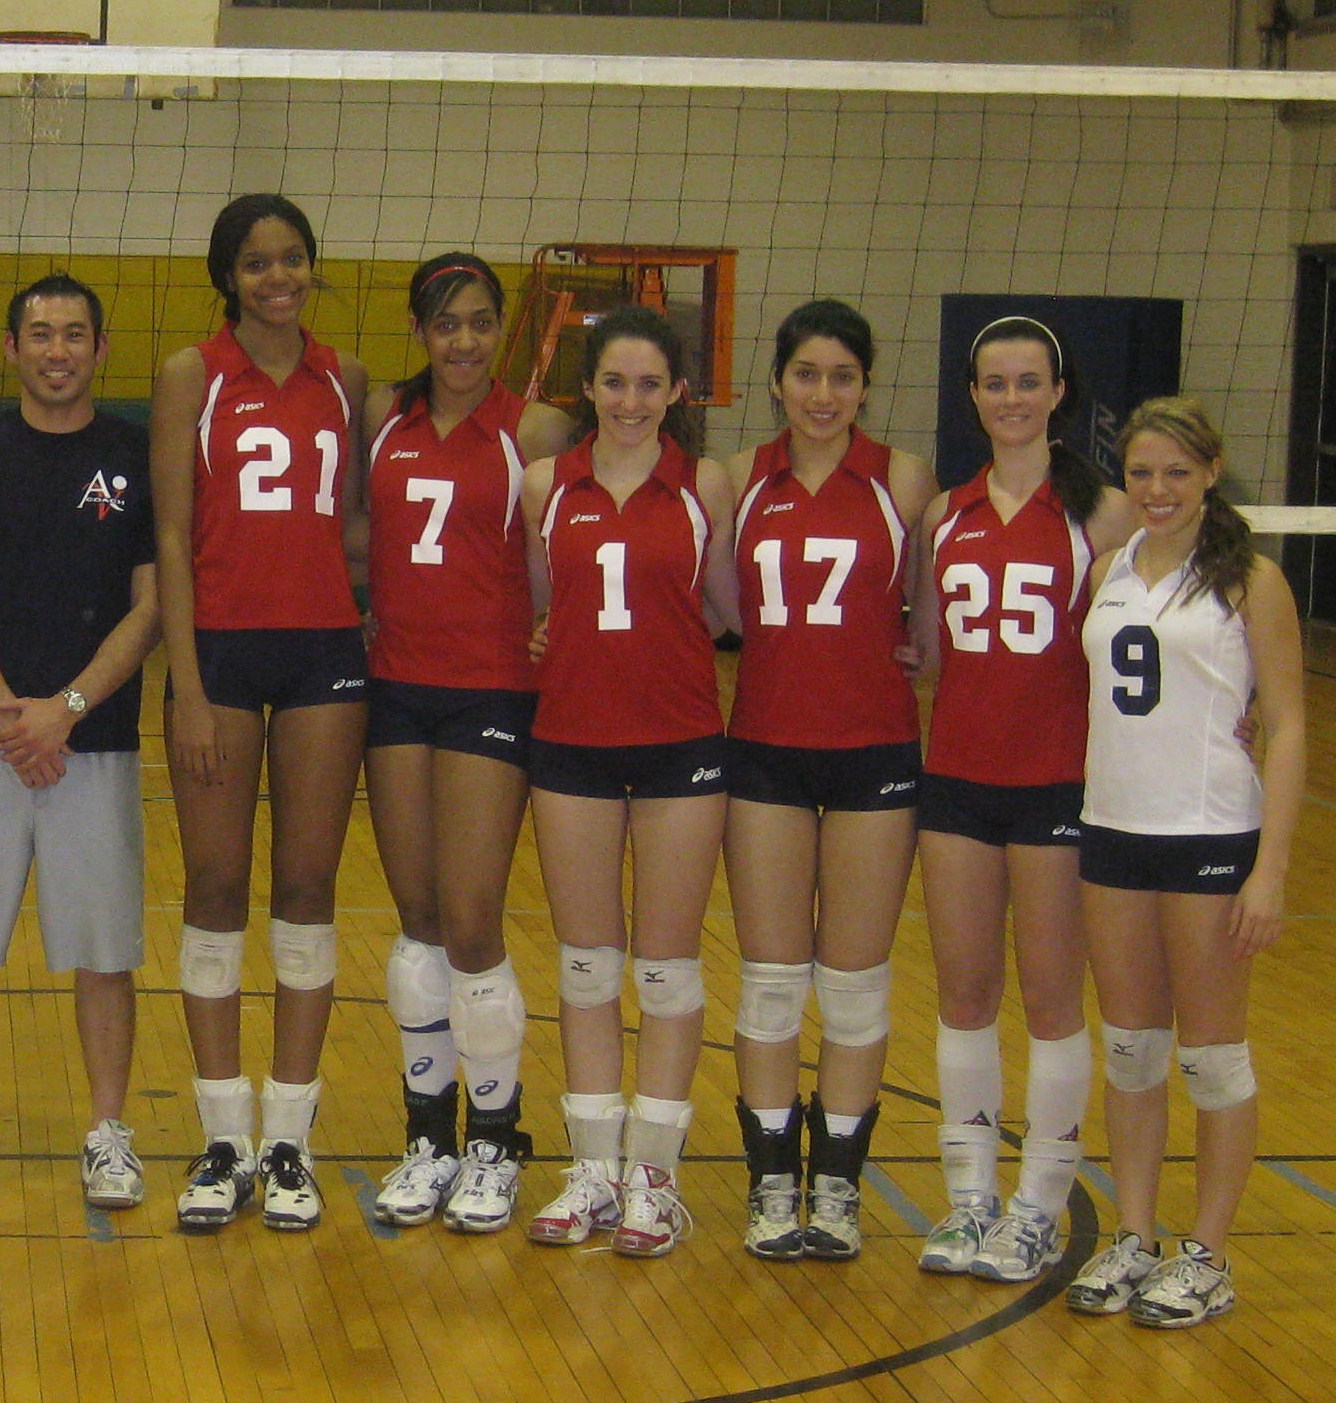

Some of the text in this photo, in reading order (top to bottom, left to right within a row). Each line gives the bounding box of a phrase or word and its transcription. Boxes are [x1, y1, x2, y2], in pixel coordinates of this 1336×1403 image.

[237, 427, 338, 515] 21
[407, 478, 454, 564] 7
[597, 542, 631, 630] 1
[754, 537, 857, 626] 17
[942, 562, 1054, 654] 25
[1111, 626, 1161, 716] 9
